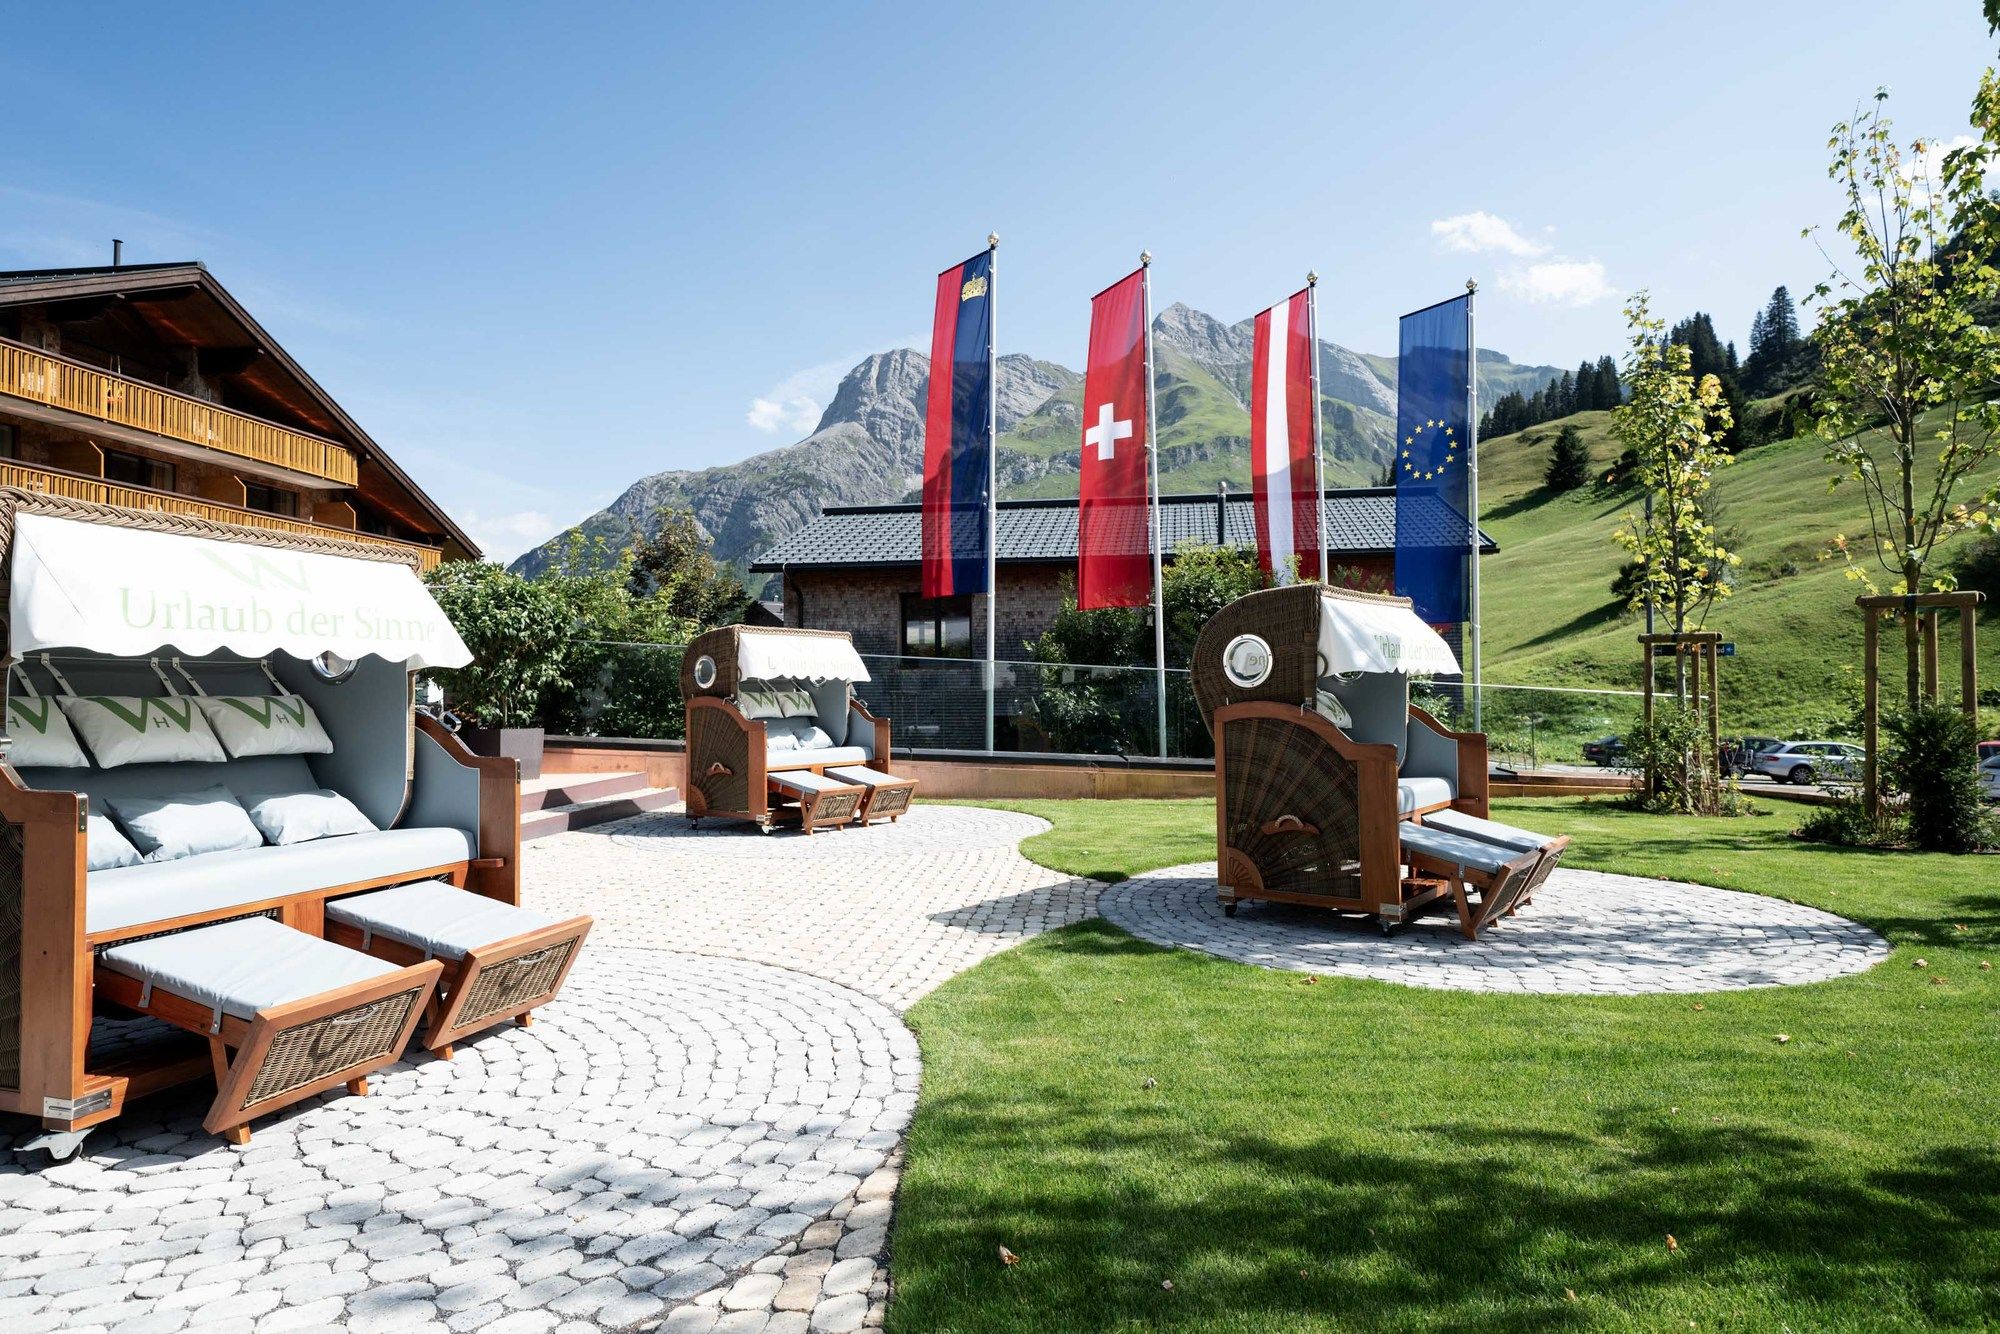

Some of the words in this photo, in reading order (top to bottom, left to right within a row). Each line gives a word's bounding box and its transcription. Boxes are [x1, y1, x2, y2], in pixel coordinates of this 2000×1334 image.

[118, 586, 272, 633] Urlaub
[287, 600, 345, 638] der
[355, 606, 436, 645] Sinne
